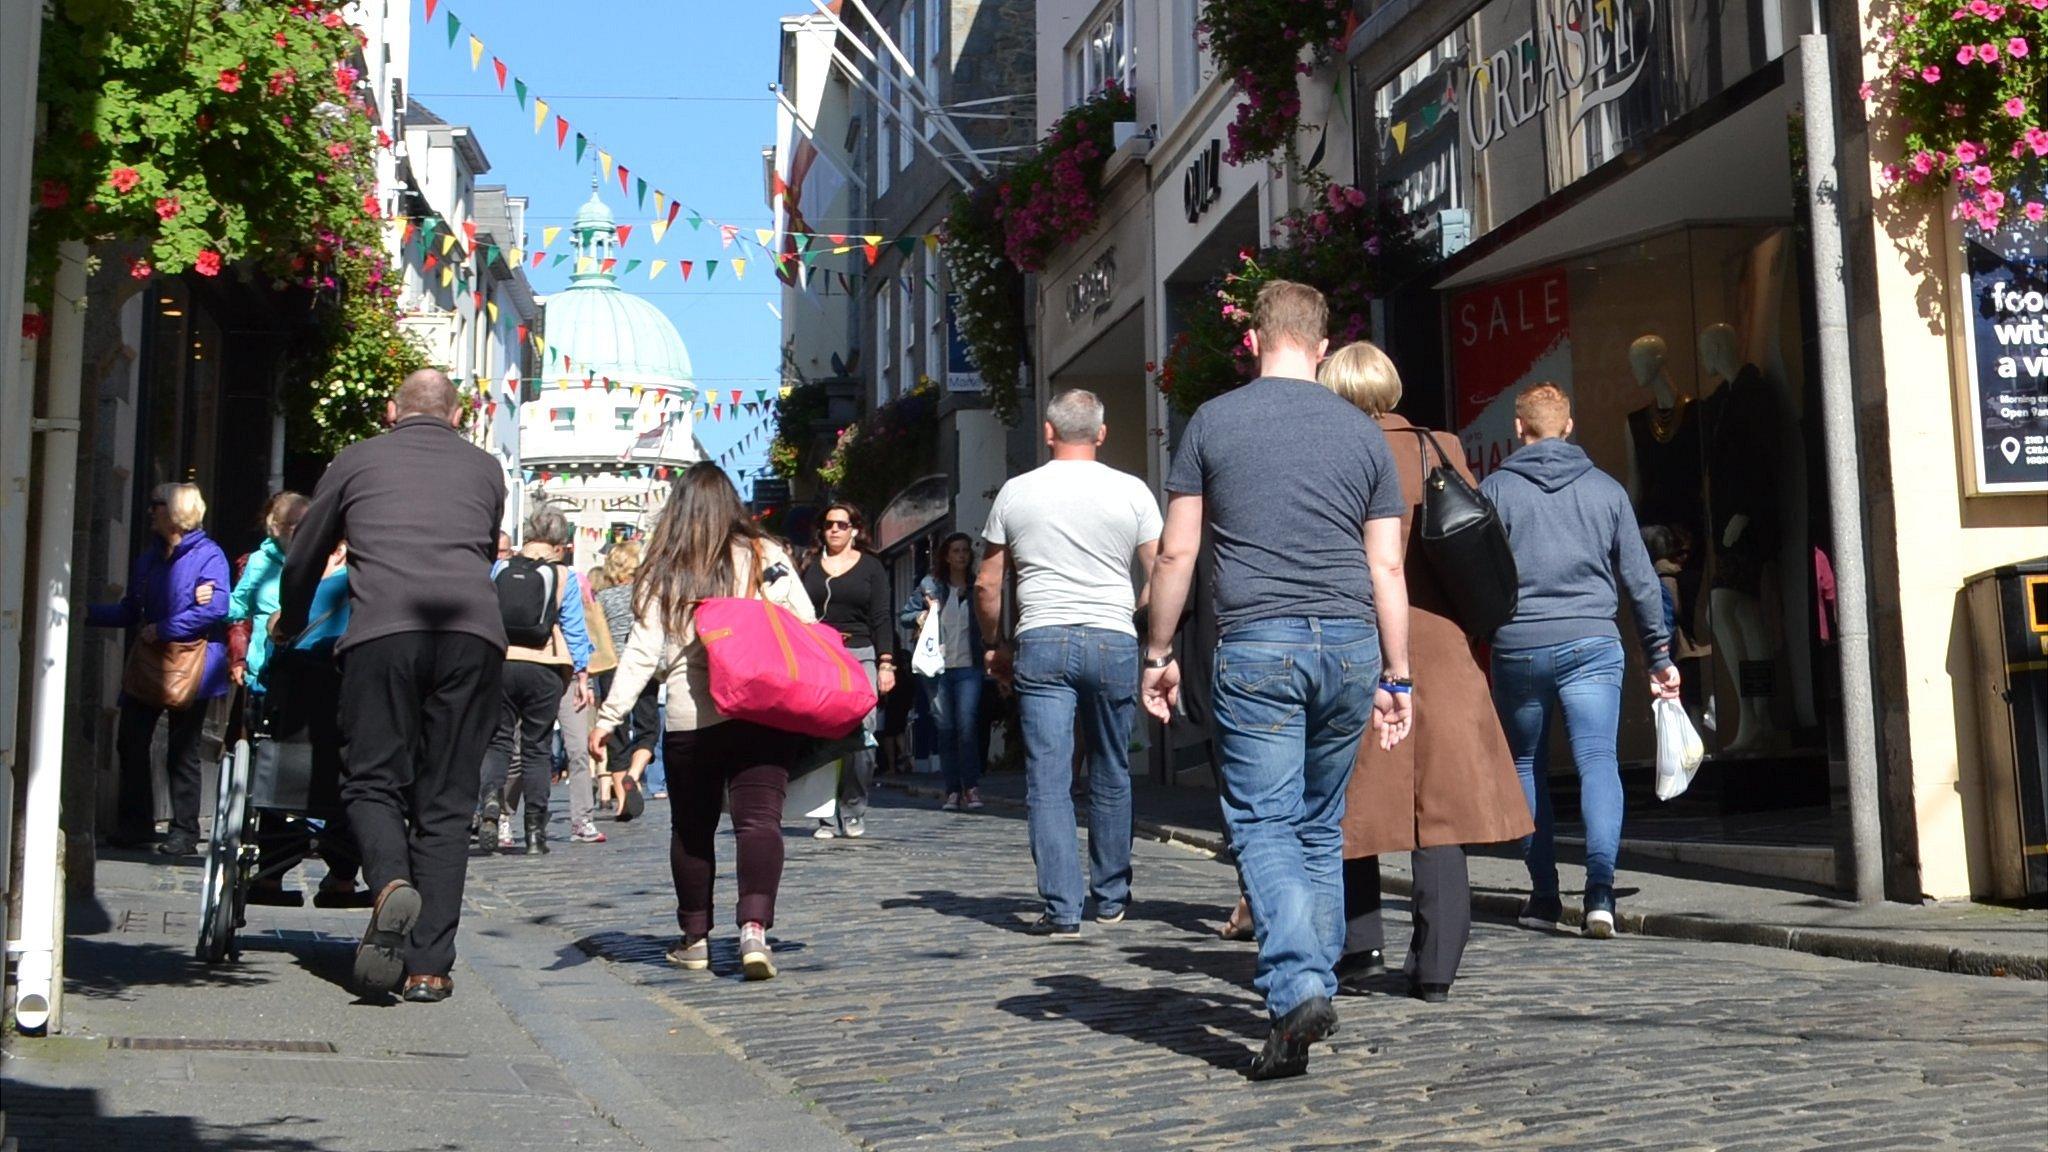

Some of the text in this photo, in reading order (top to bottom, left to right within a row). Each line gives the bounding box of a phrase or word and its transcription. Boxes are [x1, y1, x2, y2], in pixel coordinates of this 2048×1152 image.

[1992, 281, 2048, 313] foo
[1461, 279, 1560, 347] SALE
[1998, 356, 2017, 378] a
[2000, 394, 2036, 405] Morning
[2000, 407, 2029, 420] Open
